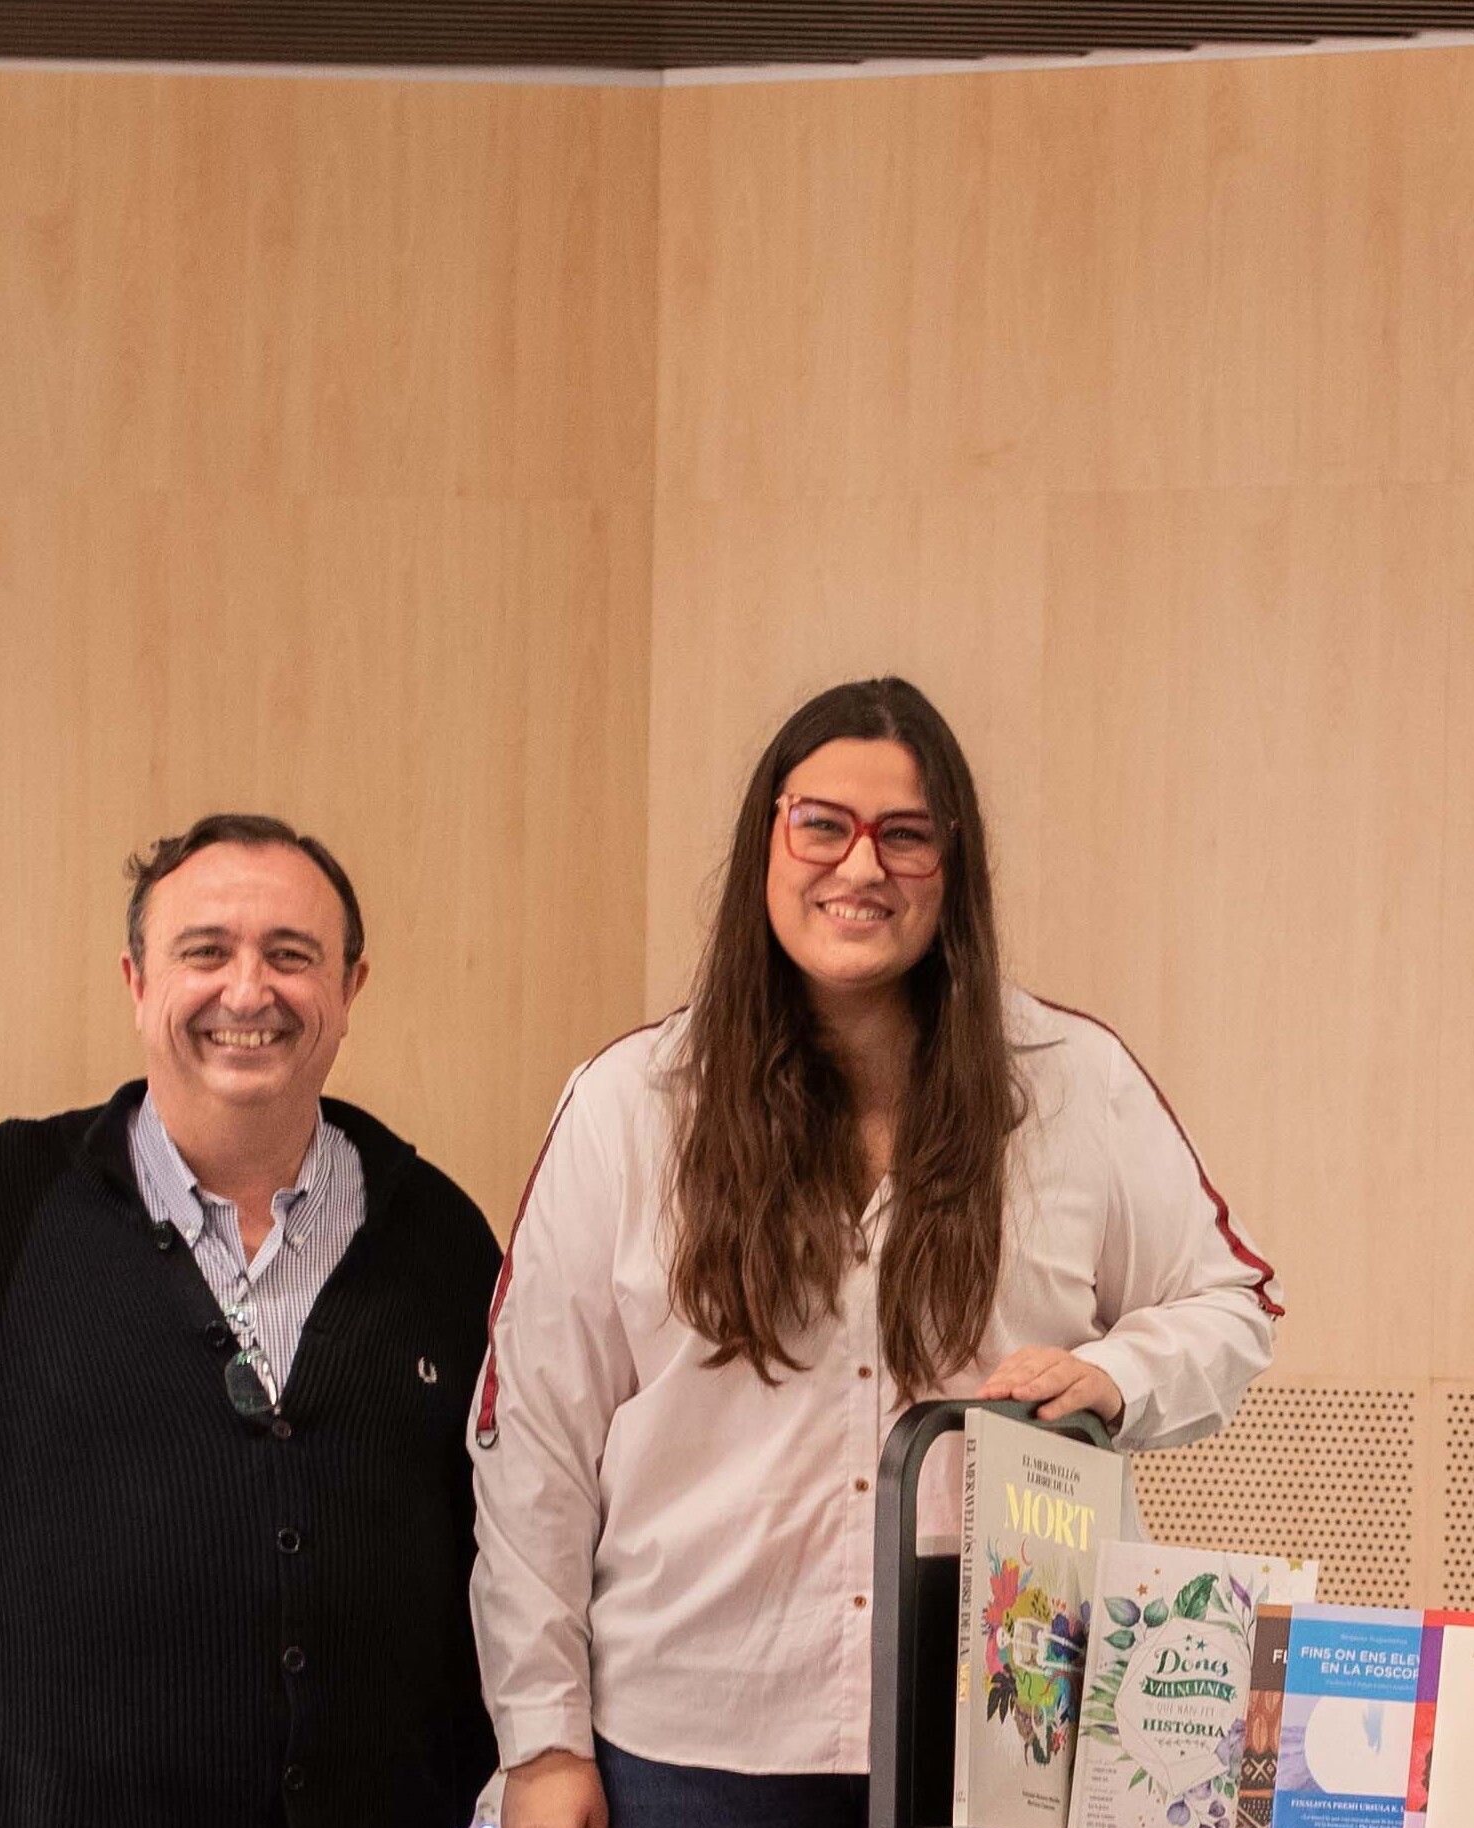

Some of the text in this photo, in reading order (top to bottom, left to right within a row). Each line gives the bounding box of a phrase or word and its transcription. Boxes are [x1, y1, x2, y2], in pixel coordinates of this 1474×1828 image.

[1004, 1483, 1095, 1551] MORT
[1153, 1646, 1228, 1677] Dones
[1301, 1646, 1386, 1664] FINS ON ENS
[1321, 1661, 1339, 1674] EN
[1343, 1664, 1361, 1676] LA
